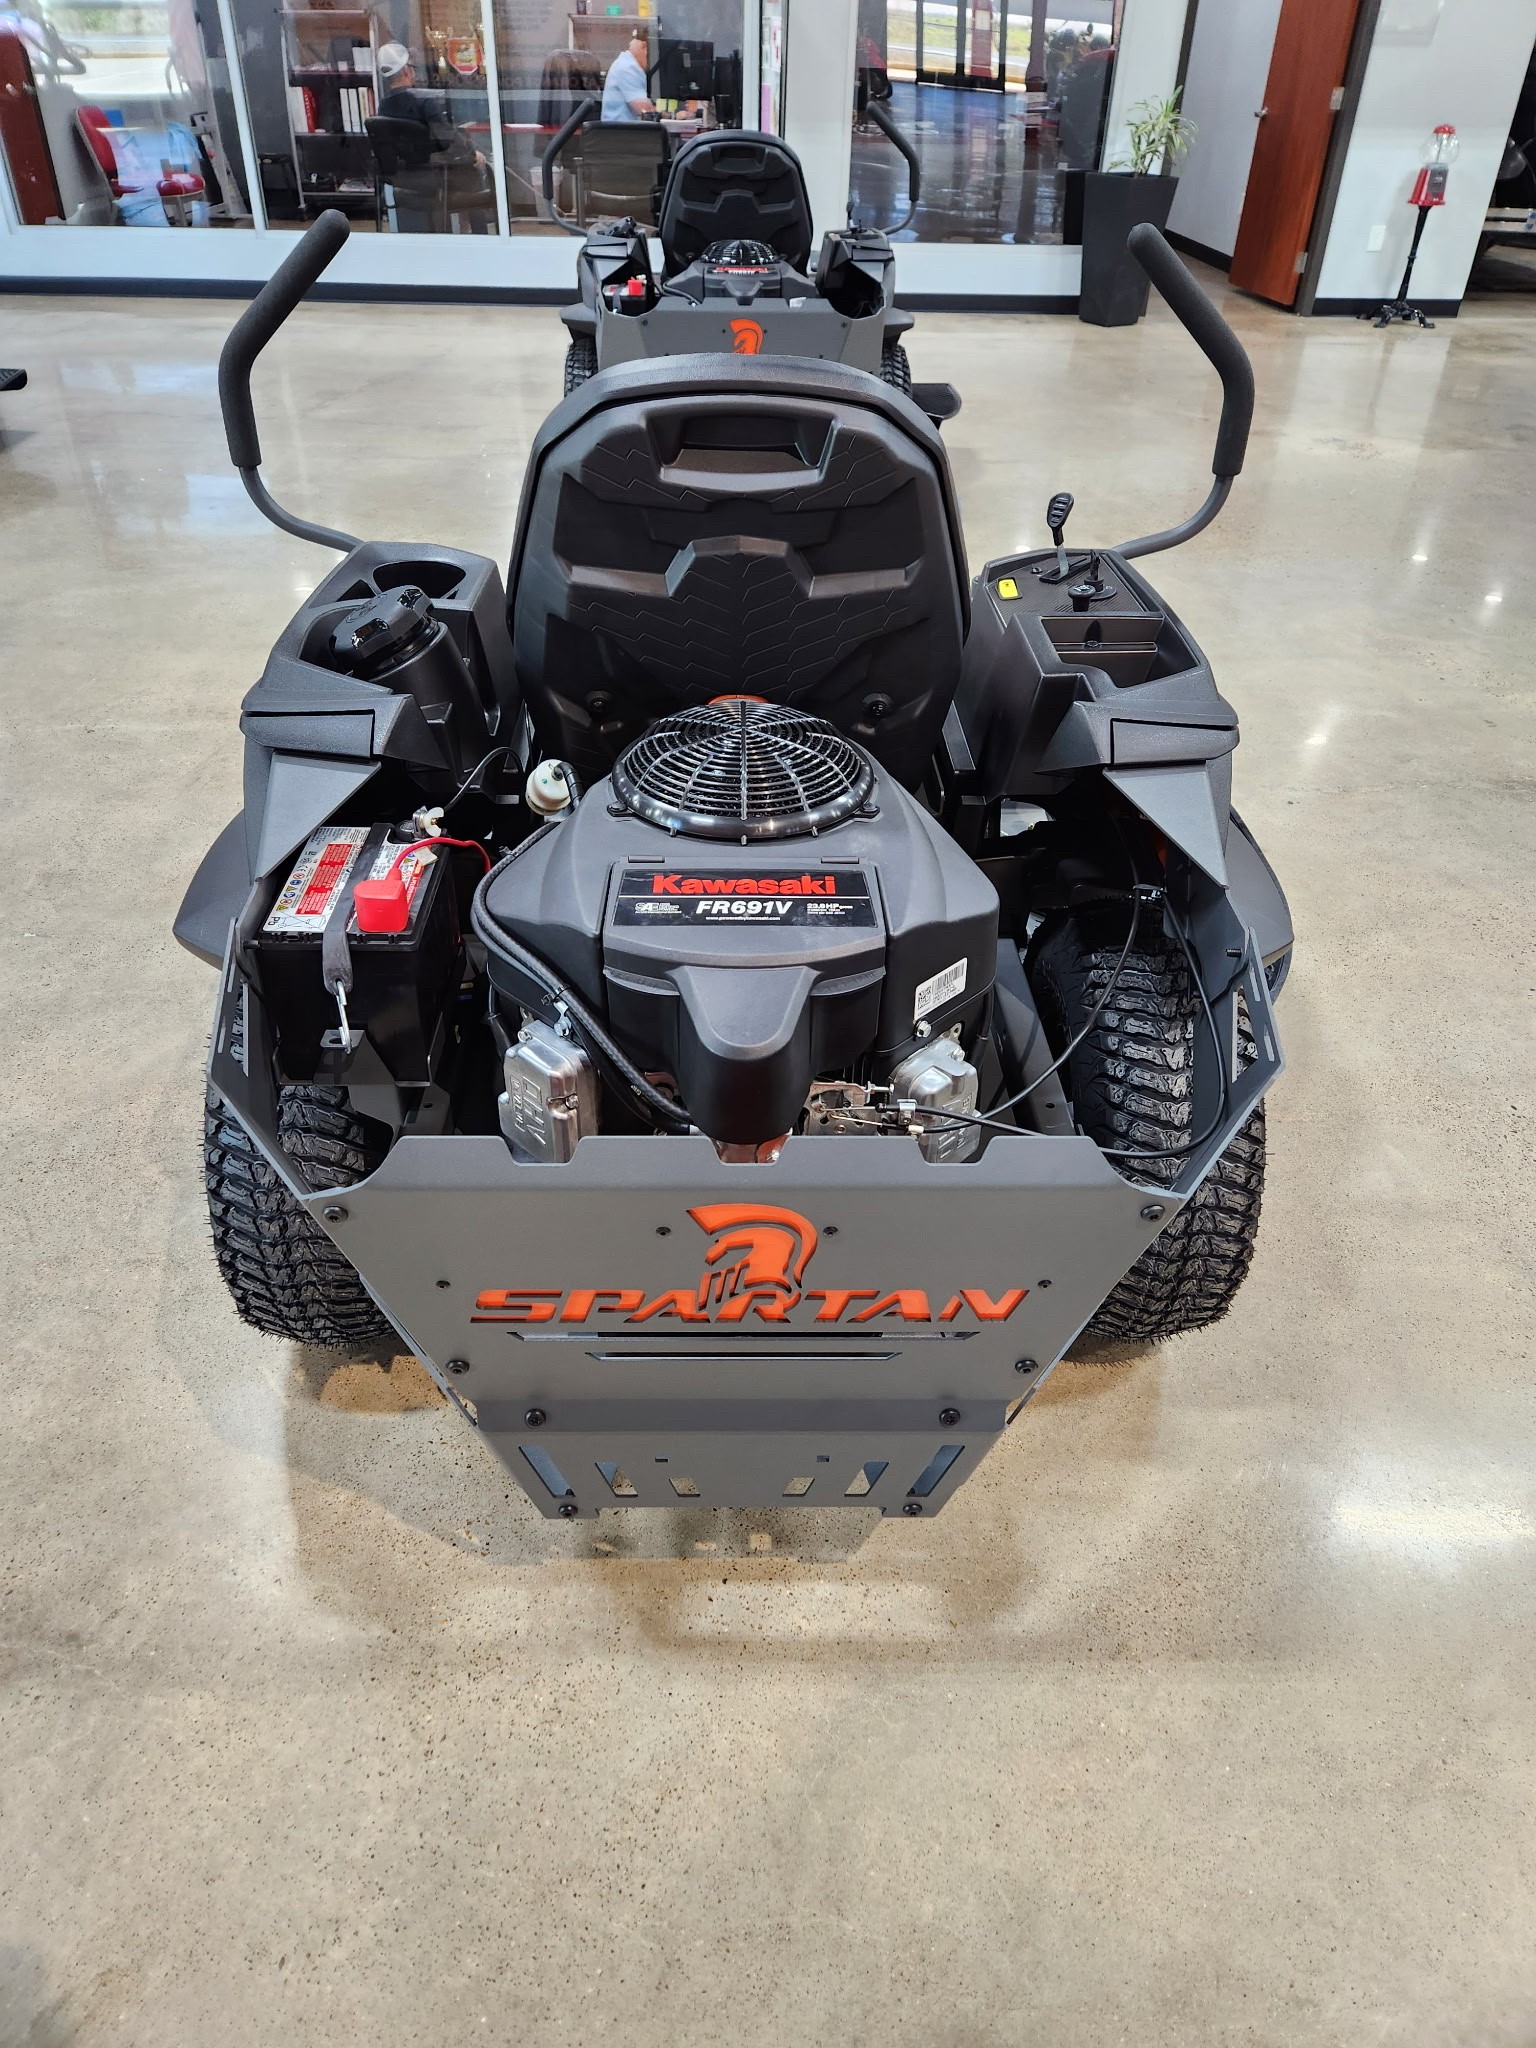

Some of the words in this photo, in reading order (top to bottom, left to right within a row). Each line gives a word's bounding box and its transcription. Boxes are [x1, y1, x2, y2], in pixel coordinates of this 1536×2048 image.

[652, 874, 837, 895] Kawasaki
[696, 900, 794, 915] FR691V
[470, 1289, 1030, 1325] SPARTAN
